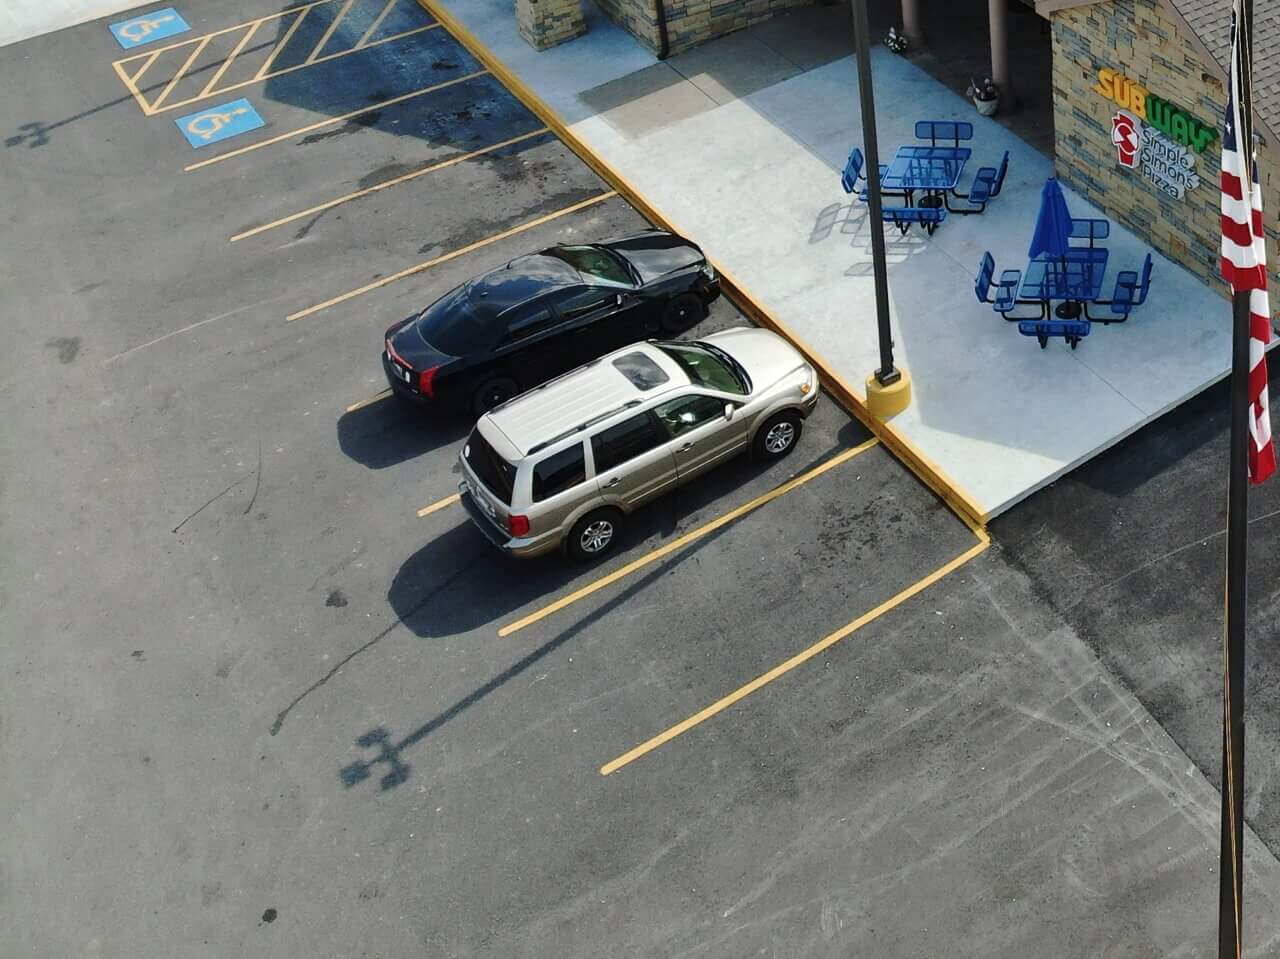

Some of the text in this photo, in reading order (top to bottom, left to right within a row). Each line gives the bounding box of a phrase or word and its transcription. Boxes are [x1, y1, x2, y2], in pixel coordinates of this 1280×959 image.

[1092, 67, 1219, 154] SUBWAY
[1142, 129, 1190, 169] Simple
[1143, 164, 1180, 199] Pizza
